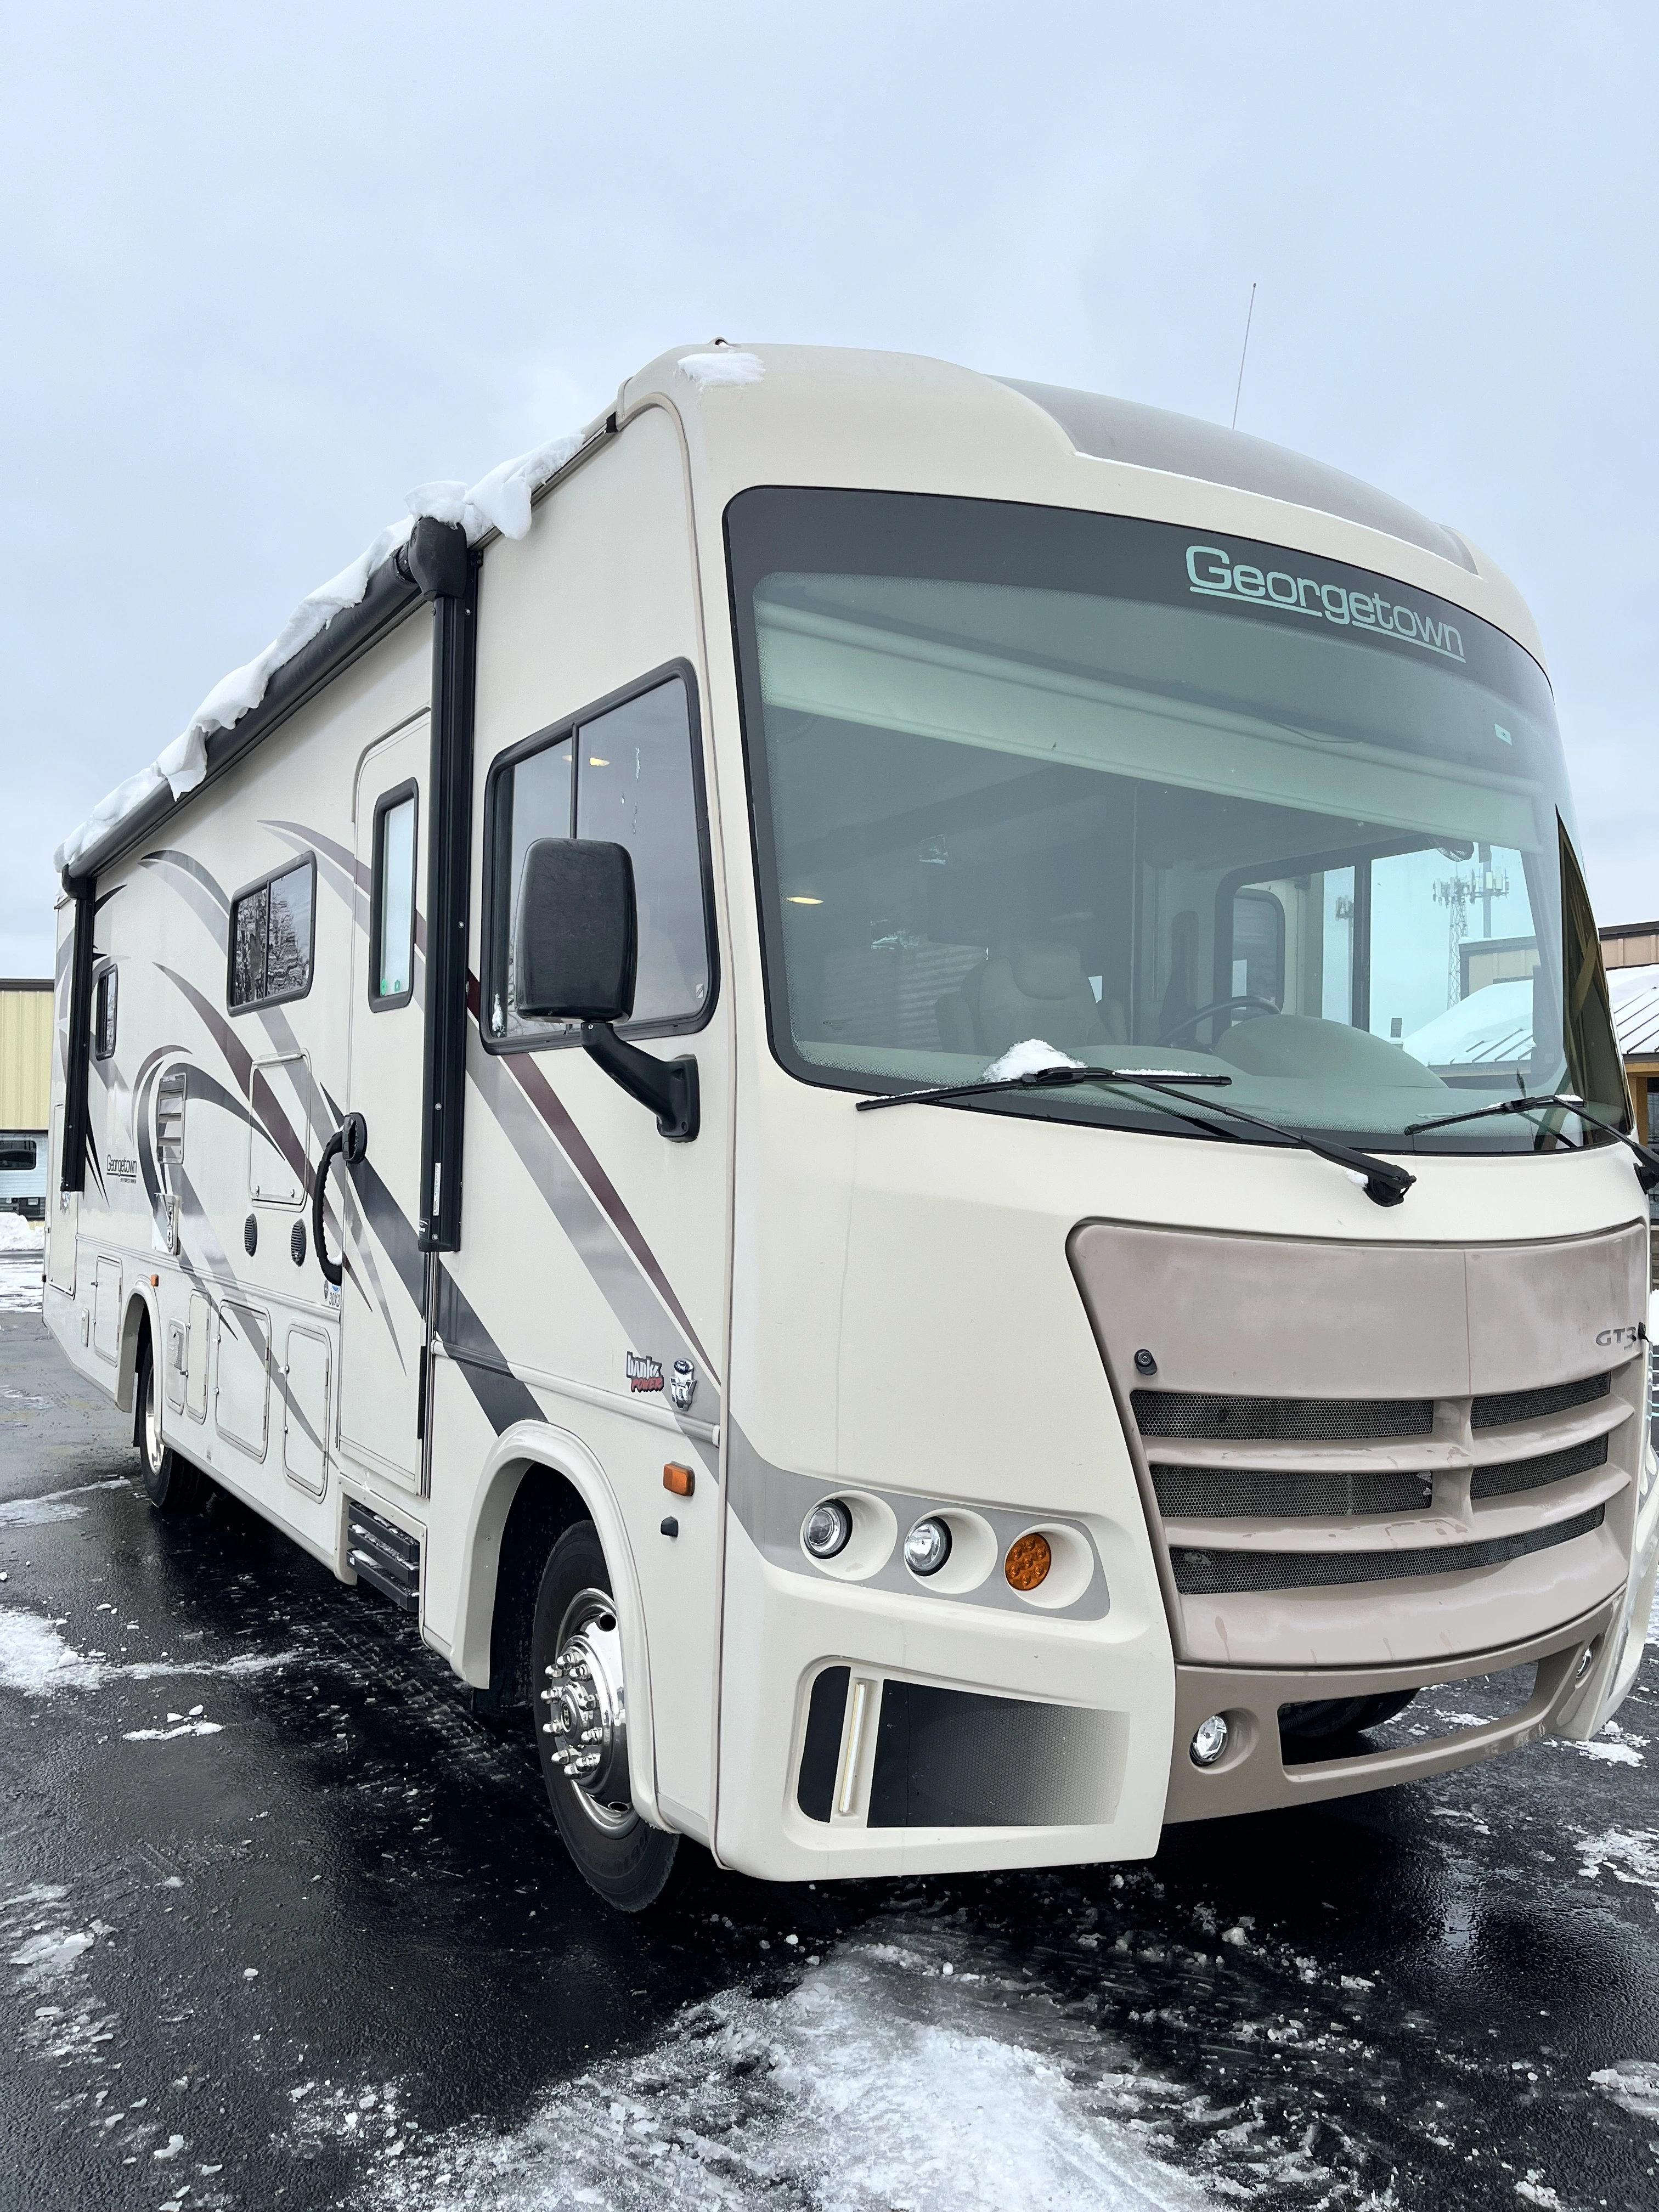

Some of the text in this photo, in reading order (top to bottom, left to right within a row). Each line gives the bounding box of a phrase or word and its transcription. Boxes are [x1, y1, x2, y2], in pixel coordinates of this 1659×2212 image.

[1186, 545, 1464, 658] Georgetown
[106, 1154, 137, 1177] Georgetown
[329, 1292, 340, 1307] 30X3
[1596, 1327, 1636, 1351] GT3
[631, 1377, 663, 1392] POWER
